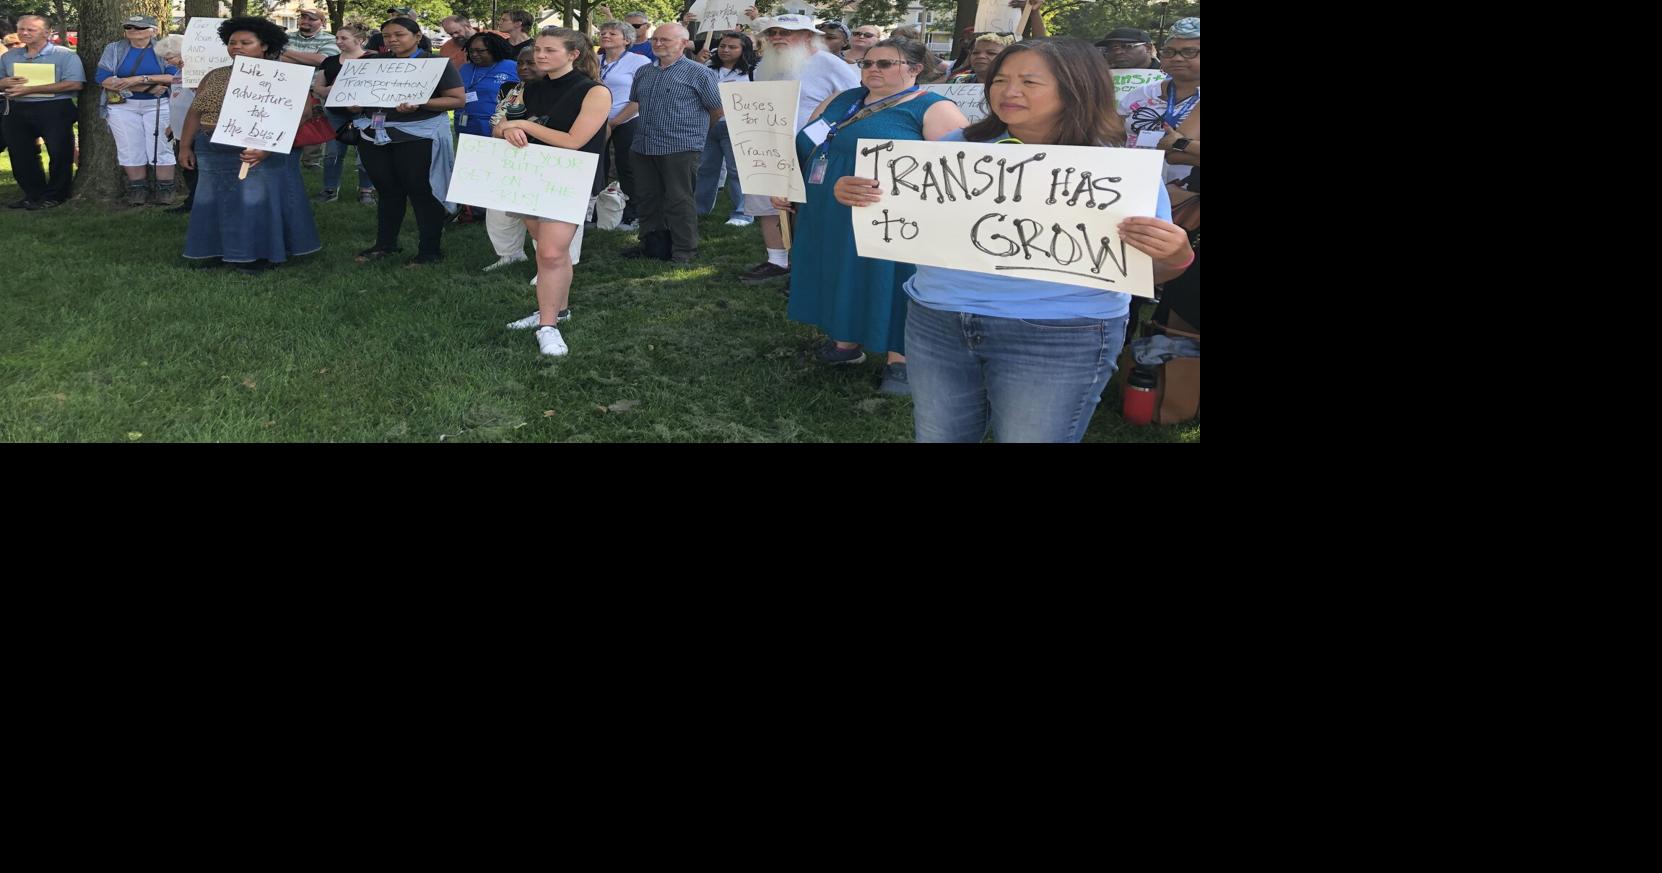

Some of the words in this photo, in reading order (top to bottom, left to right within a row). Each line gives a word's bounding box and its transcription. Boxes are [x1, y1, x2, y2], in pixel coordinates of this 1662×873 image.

[239, 62, 264, 77] Life
[343, 62, 370, 76] WE
[259, 80, 272, 92] an
[944, 84, 984, 96] NEE
[335, 91, 357, 102] ON
[731, 93, 774, 112] Buses
[766, 114, 788, 127] Us
[222, 118, 243, 137] the
[248, 122, 285, 146] bus!
[734, 140, 781, 158] Trains
[540, 152, 584, 168] YOUR
[861, 140, 1046, 204] TRANSIT
[1045, 167, 1123, 211] HAS
[871, 208, 920, 243] to
[970, 213, 1128, 277] GROW
